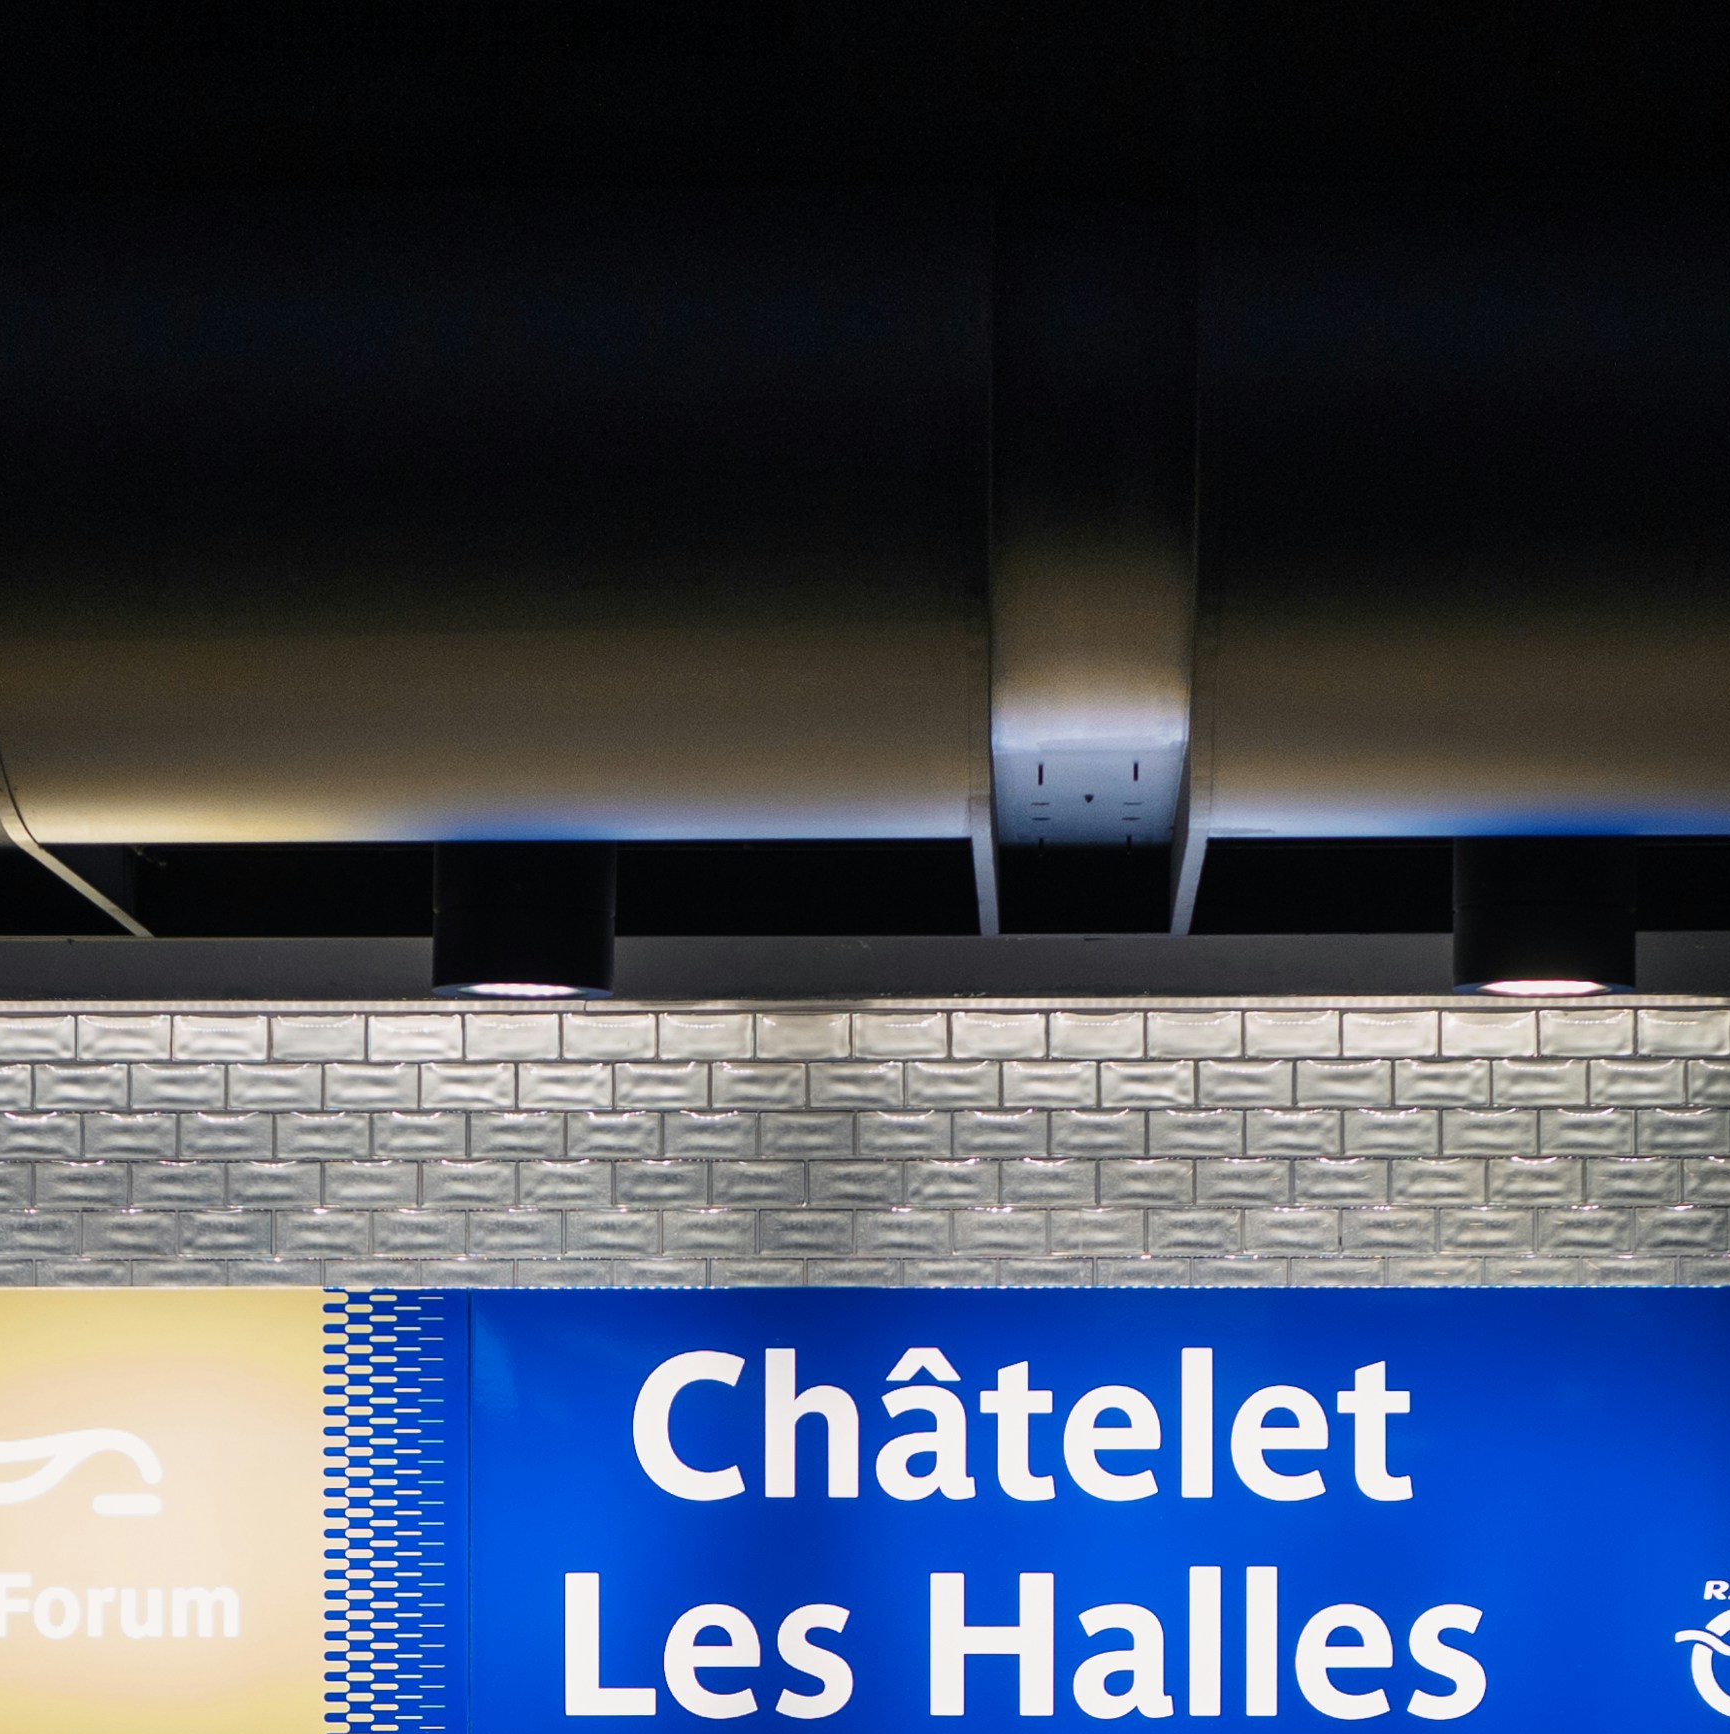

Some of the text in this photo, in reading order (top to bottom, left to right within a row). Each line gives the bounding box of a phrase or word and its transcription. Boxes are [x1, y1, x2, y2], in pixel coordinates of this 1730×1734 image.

[632, 1346, 1414, 1502] Châtelet
[564, 1565, 1487, 1721] Les Halles
